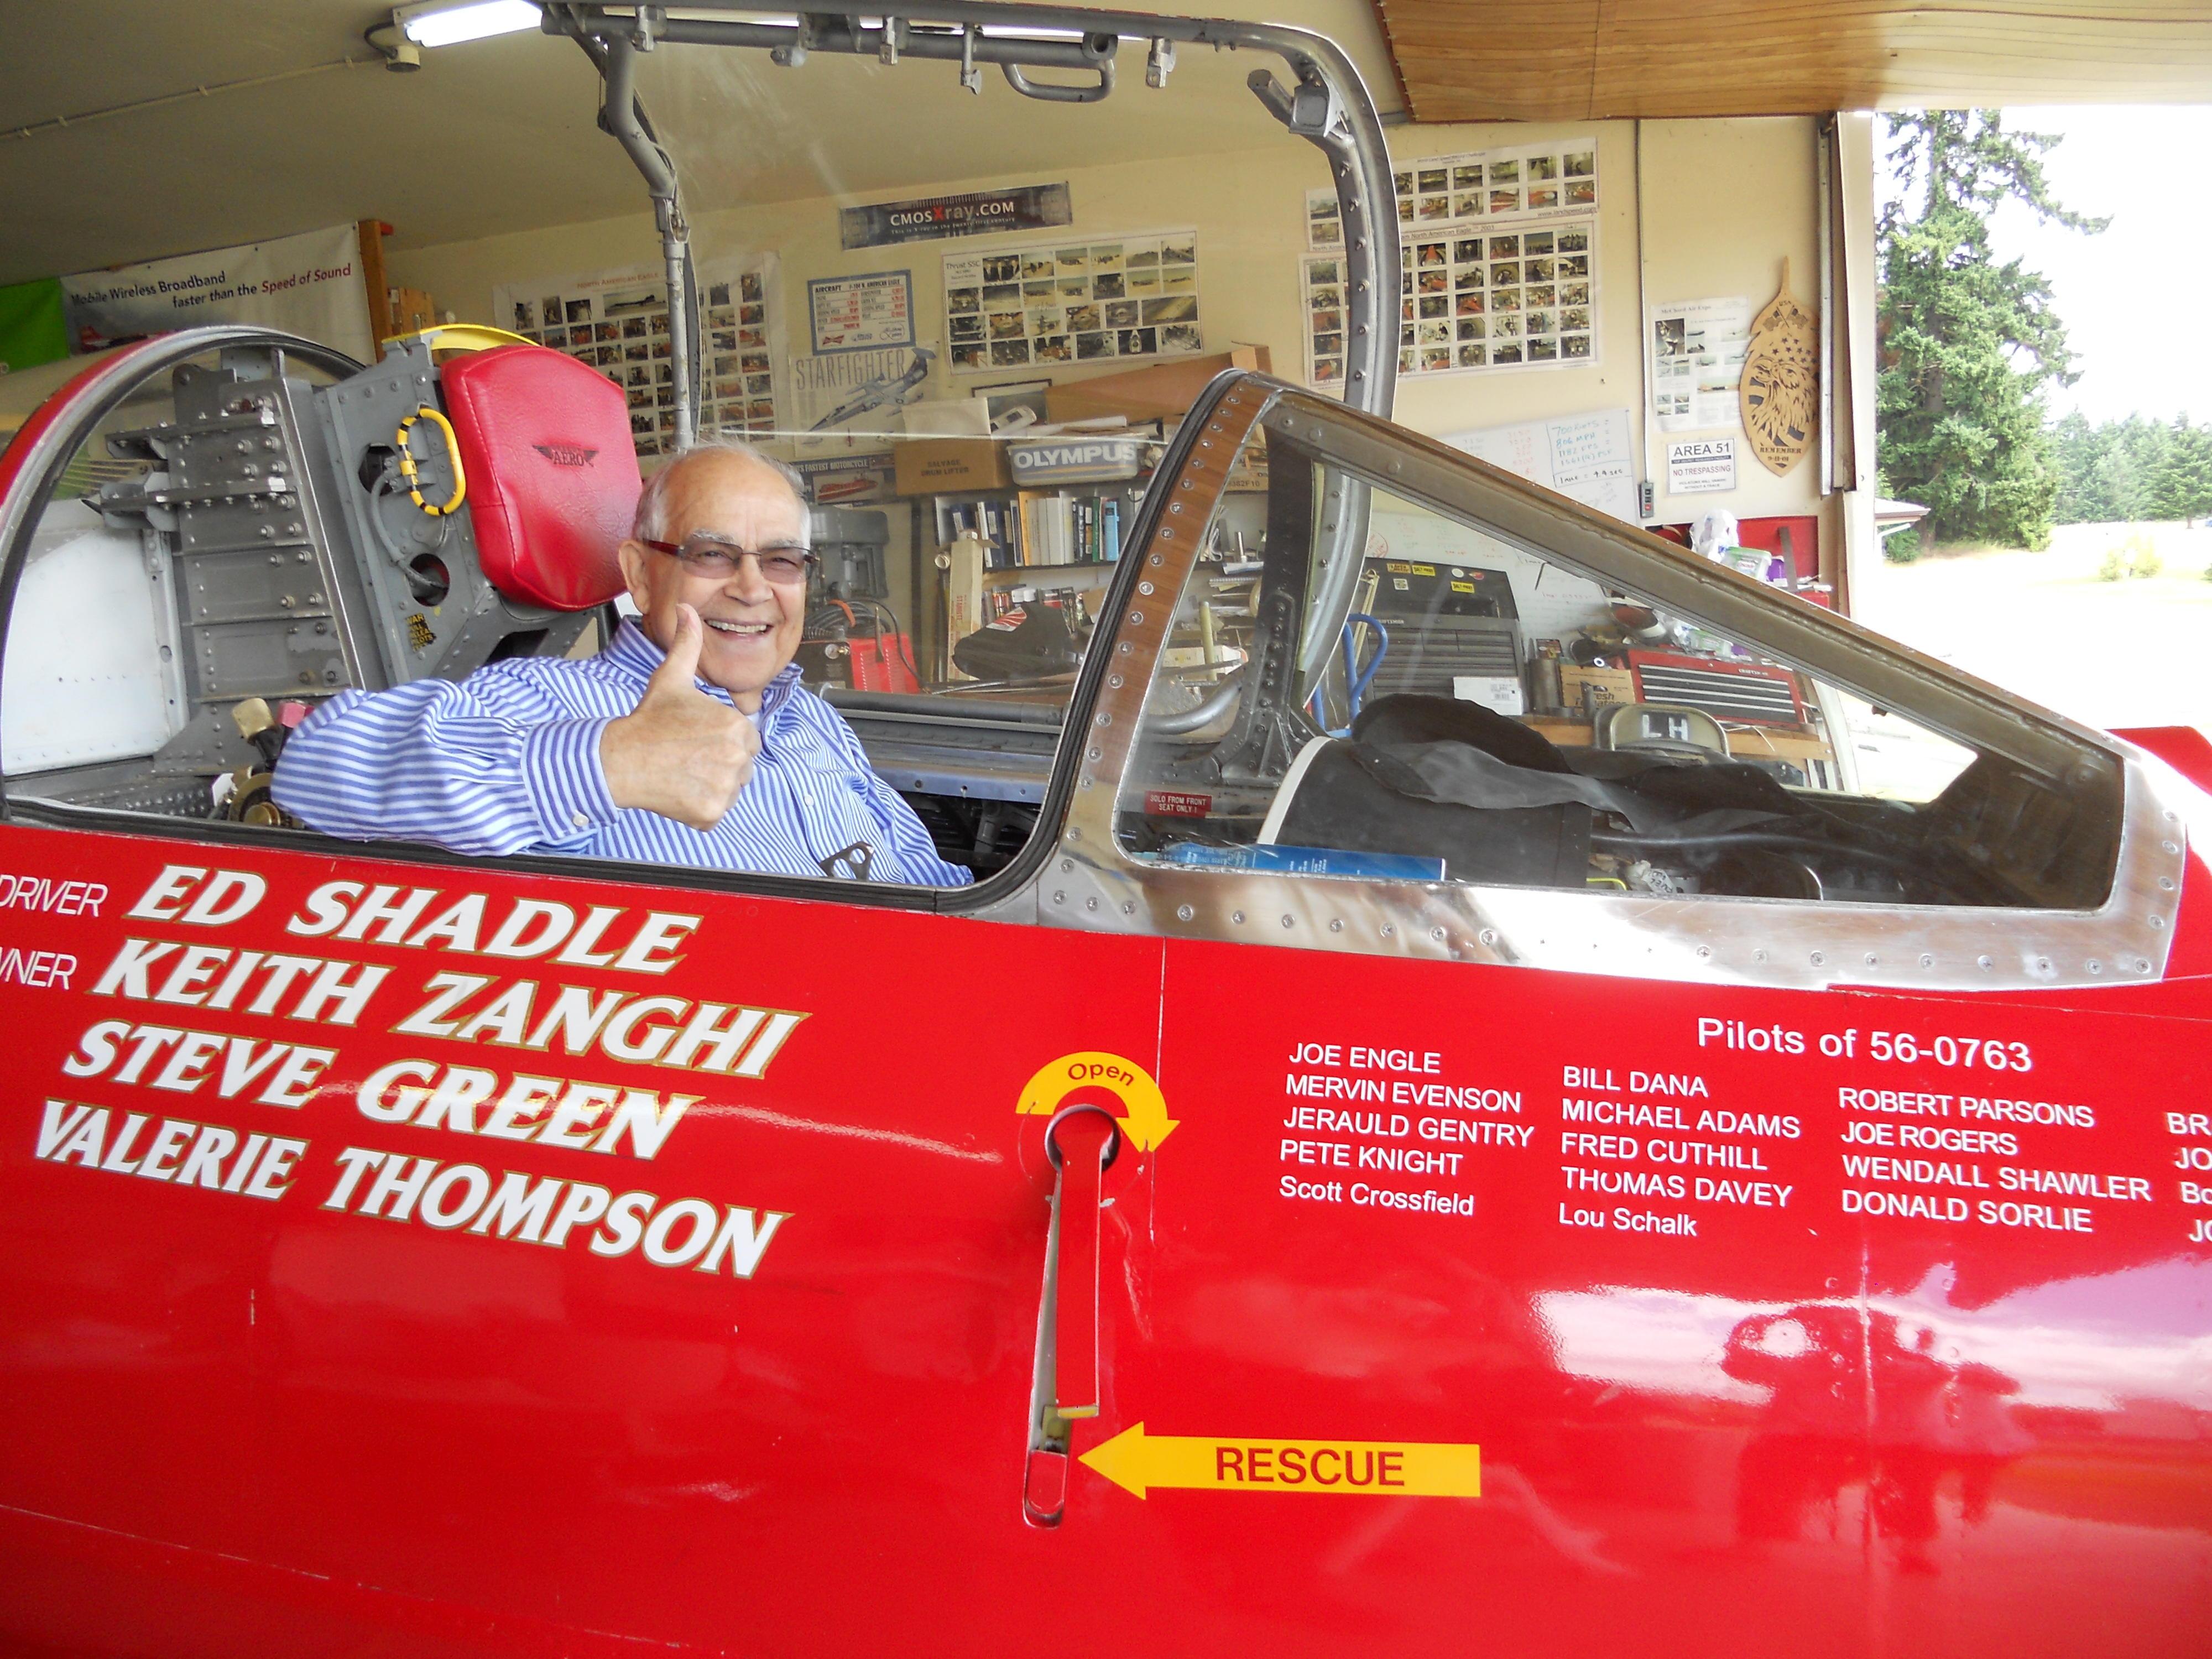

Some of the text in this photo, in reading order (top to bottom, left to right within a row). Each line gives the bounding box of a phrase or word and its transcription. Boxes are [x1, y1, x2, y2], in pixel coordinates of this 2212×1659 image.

[890, 201, 1015, 227] CMOSXray.COM
[71, 271, 226, 306] Mobile Wireless Broadband
[173, 263, 352, 309] faster than the Speed of Sound
[815, 285, 842, 293] AIRCRAFT
[796, 349, 906, 390] STARFIGHTER
[554, 451, 585, 467] AERO
[805, 463, 828, 472] FASTEST
[831, 460, 868, 469] MOTORCYCLE
[1014, 444, 1135, 469] OLYMPUS
[1674, 442, 1730, 457] AREA 51
[1685, 465, 1731, 475] TRESPASSING
[1168, 796, 1185, 804] FROM
[1187, 797, 1206, 806] FRONT
[0, 864, 704, 975] DRIVER ED SHADLE
[84, 936, 397, 1027] KEITH
[388, 968, 813, 1079] ZANGHI
[1288, 1042, 1441, 1074] JOE ENGLE
[1697, 1017, 2033, 1073] Pilots of 56-0763
[61, 1018, 707, 1161] STEVE GREEN
[1068, 1063, 1134, 1086] Open
[1285, 1073, 1521, 1113] MERVIN EVENSON
[1563, 1065, 1709, 1098] BILL DANA
[1283, 1106, 1535, 1147] JERAULD GENTRY
[1562, 1098, 1801, 1139] MICHAEL ADAMS
[1838, 1087, 2096, 1129] ROBERT PARSONS
[1280, 1139, 1464, 1176] PETE KNIGHT
[1561, 1131, 1768, 1171] FRED CUTHILL
[1840, 1121, 2019, 1156] JOE ROGERS
[33, 1096, 795, 1281] VALERIE THOMPSON
[1279, 1175, 1475, 1217] Scott Crossfield
[1561, 1165, 1793, 1208] THOMAS DAVEY
[1841, 1154, 2153, 1202] WENDALL SHAWLER
[1558, 1202, 1697, 1237] Lou Schalk
[1841, 1189, 2093, 1233] DONALD SORLIE
[1216, 1446, 1405, 1487] RESCUE
